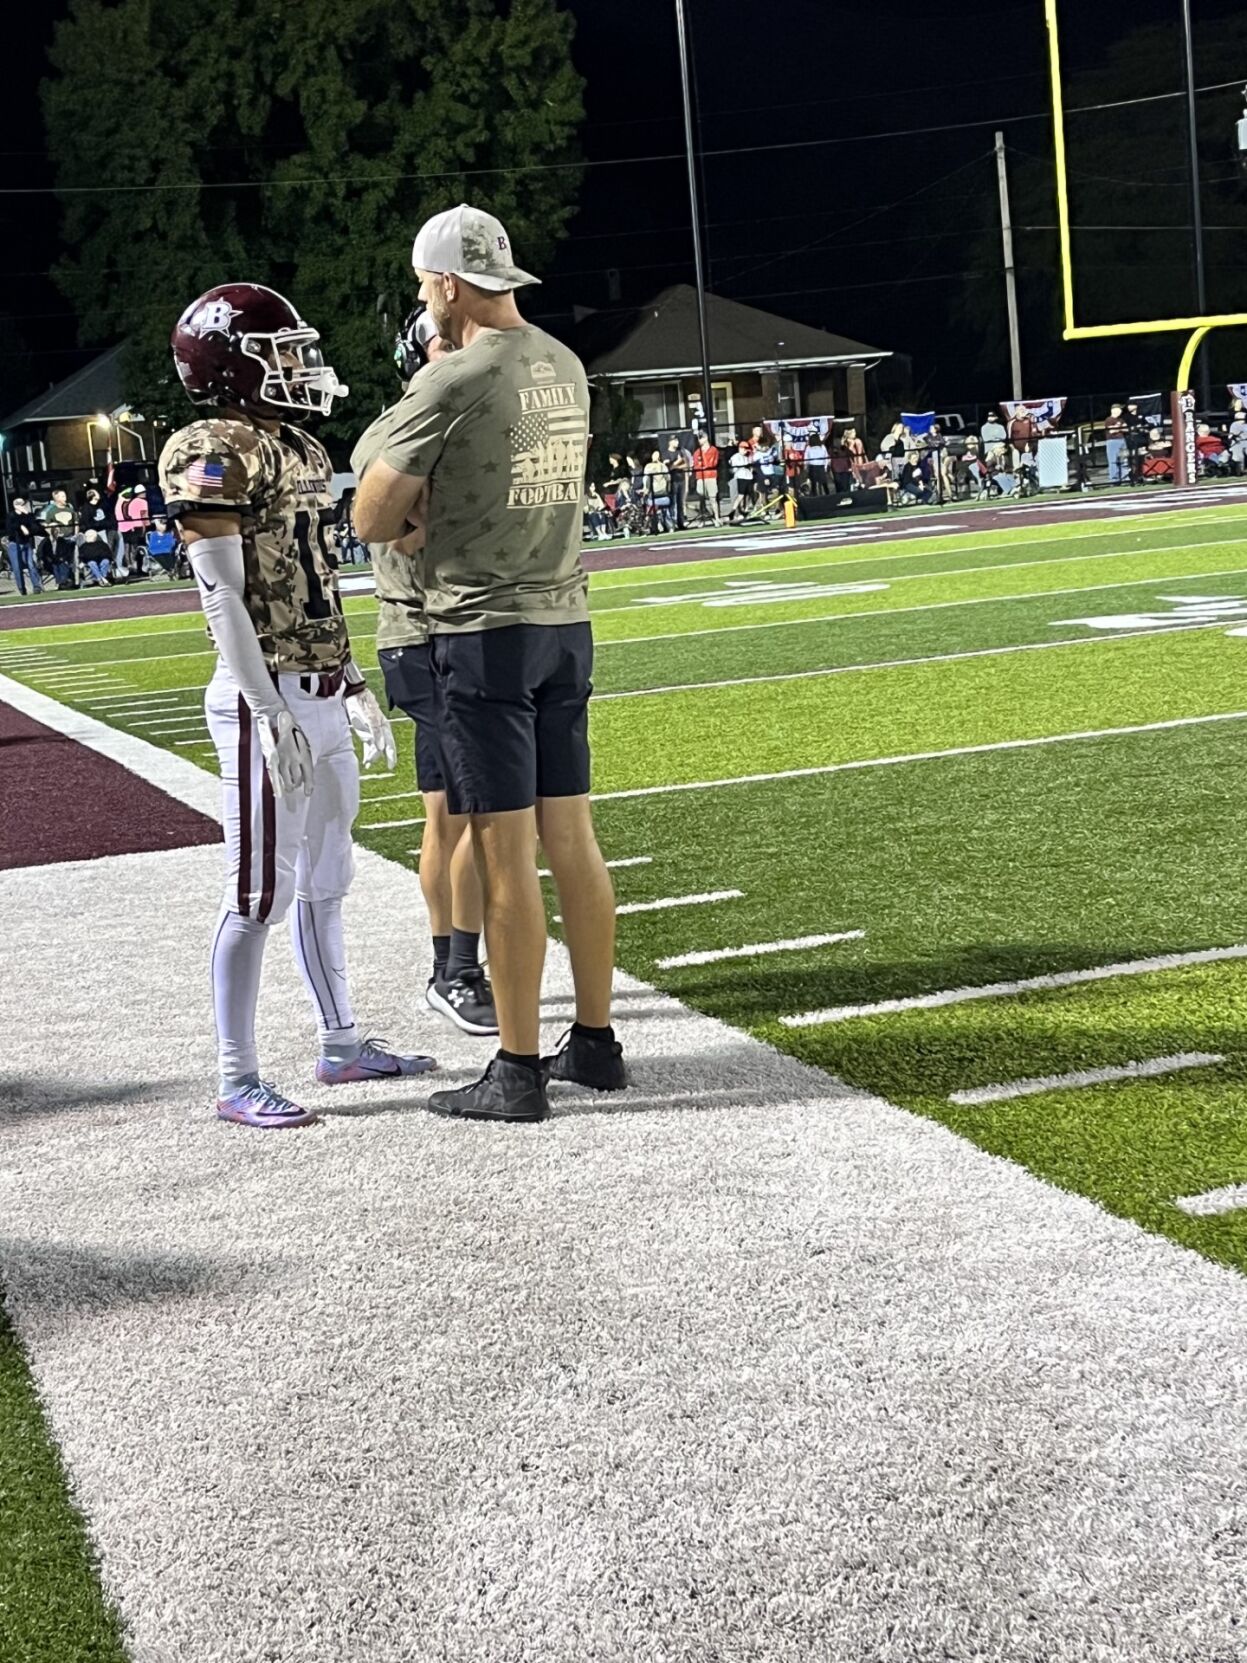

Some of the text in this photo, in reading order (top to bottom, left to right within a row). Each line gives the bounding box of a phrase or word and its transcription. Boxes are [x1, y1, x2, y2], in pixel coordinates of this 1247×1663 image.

[496, 235, 508, 250] B
[202, 301, 232, 330] B
[519, 386, 576, 411] FAMILY
[1184, 411, 1196, 484] RANGERS
